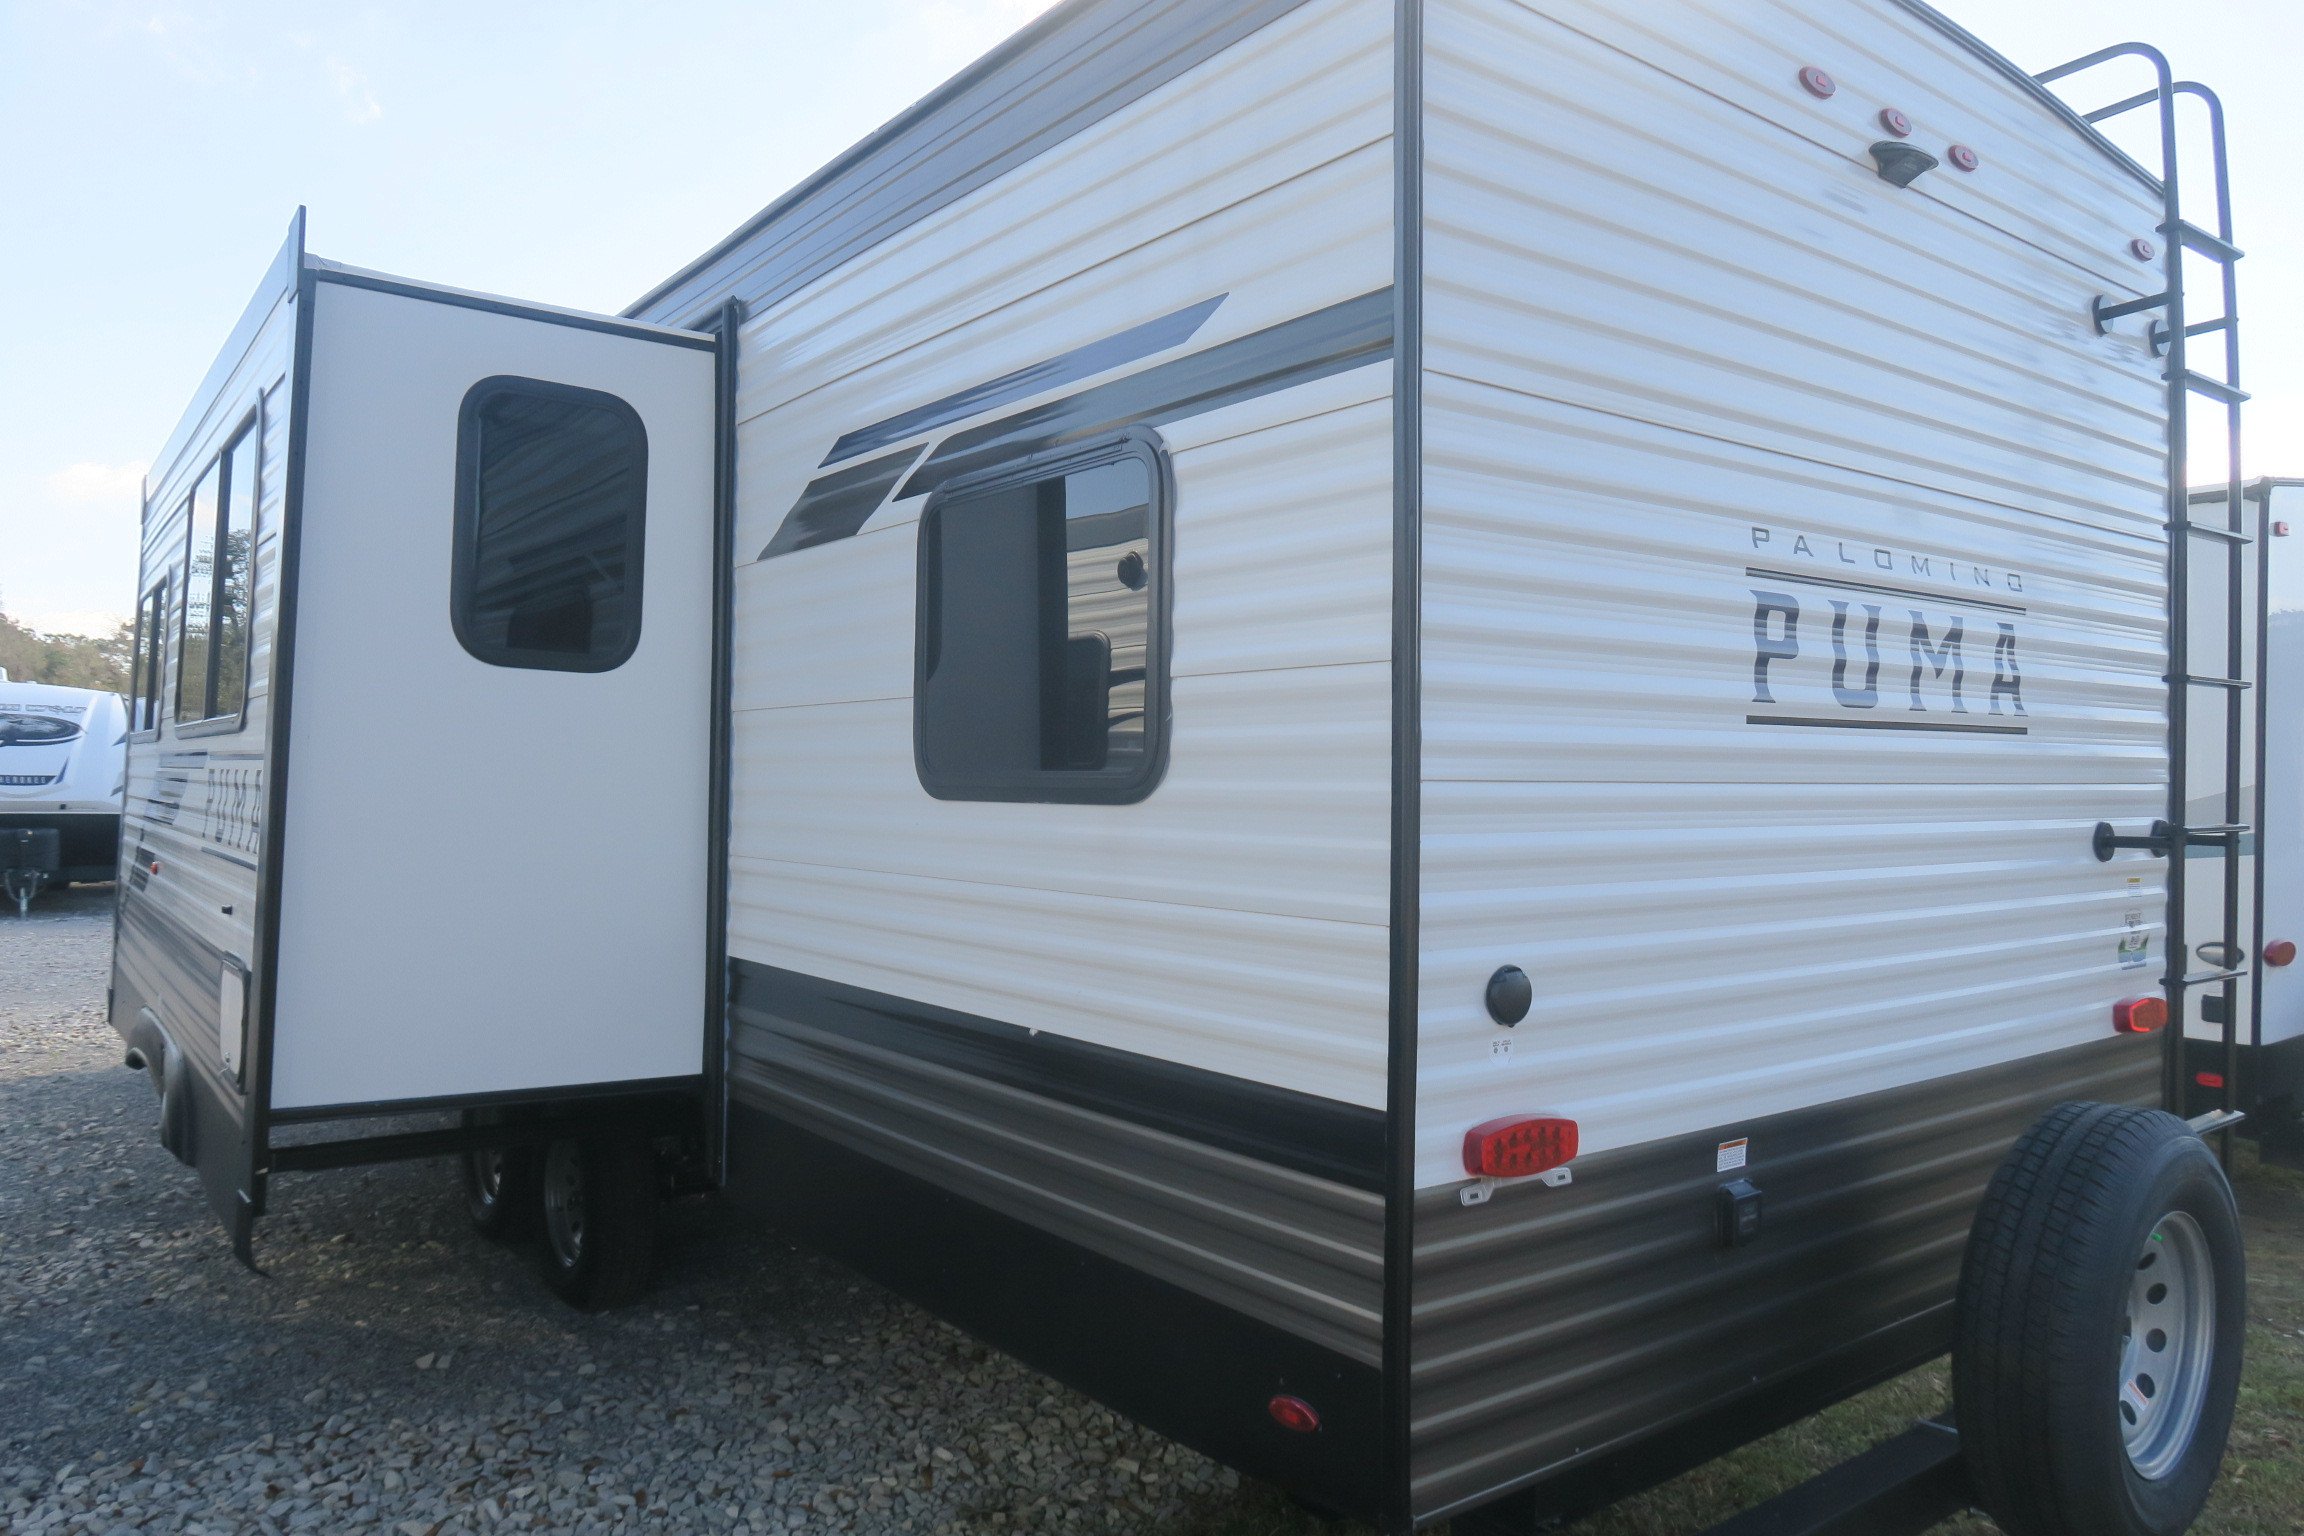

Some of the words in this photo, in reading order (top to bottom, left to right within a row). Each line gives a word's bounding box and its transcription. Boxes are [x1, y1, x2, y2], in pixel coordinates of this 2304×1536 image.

[1751, 526, 2023, 592] PALOMINO
[1749, 589, 2029, 717] PUMA
[202, 768, 262, 855] PUMA
